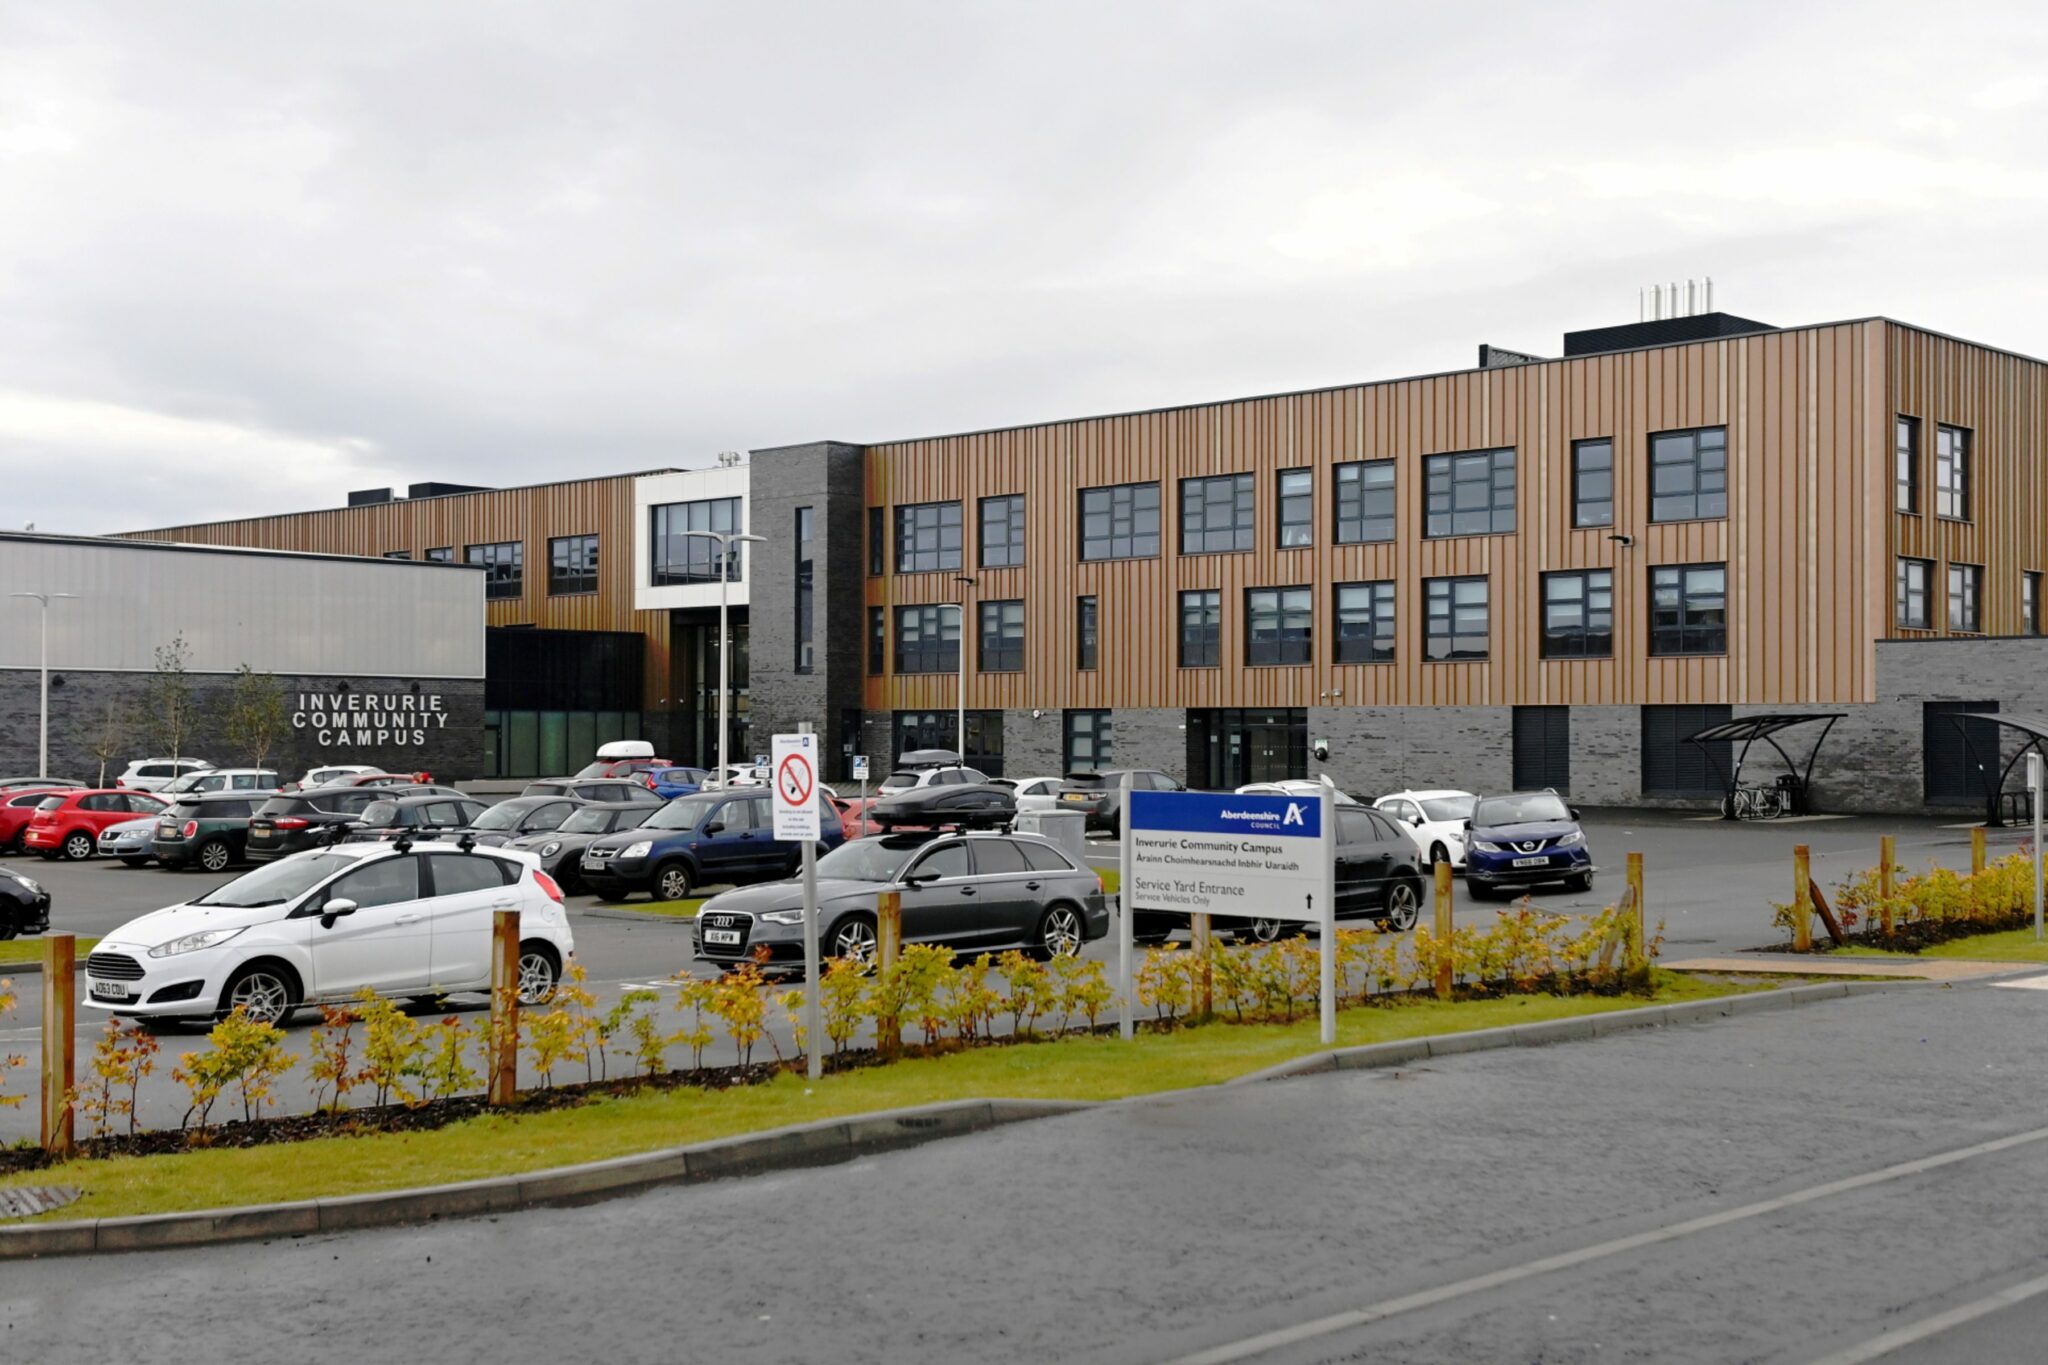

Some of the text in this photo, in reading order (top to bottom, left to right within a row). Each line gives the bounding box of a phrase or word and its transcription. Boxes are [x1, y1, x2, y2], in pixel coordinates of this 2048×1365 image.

[300, 694, 442, 711] INVERURIE
[292, 712, 449, 728] COMMUNITY
[318, 729, 425, 746] CAMPUS
[1220, 810, 1280, 821] Aberdeenshire
[1250, 821, 1280, 830] COUNCIL
[1135, 837, 1283, 856] Inverurie Community Campus
[1164, 854, 1236, 868] Choimhearsnachd
[1238, 859, 1263, 869] Inbhir
[1265, 860, 1300, 871] Uaraidh
[1135, 876, 1245, 896] Service Yard Entrance
[1135, 891, 1210, 908] Service Vehicles Only
